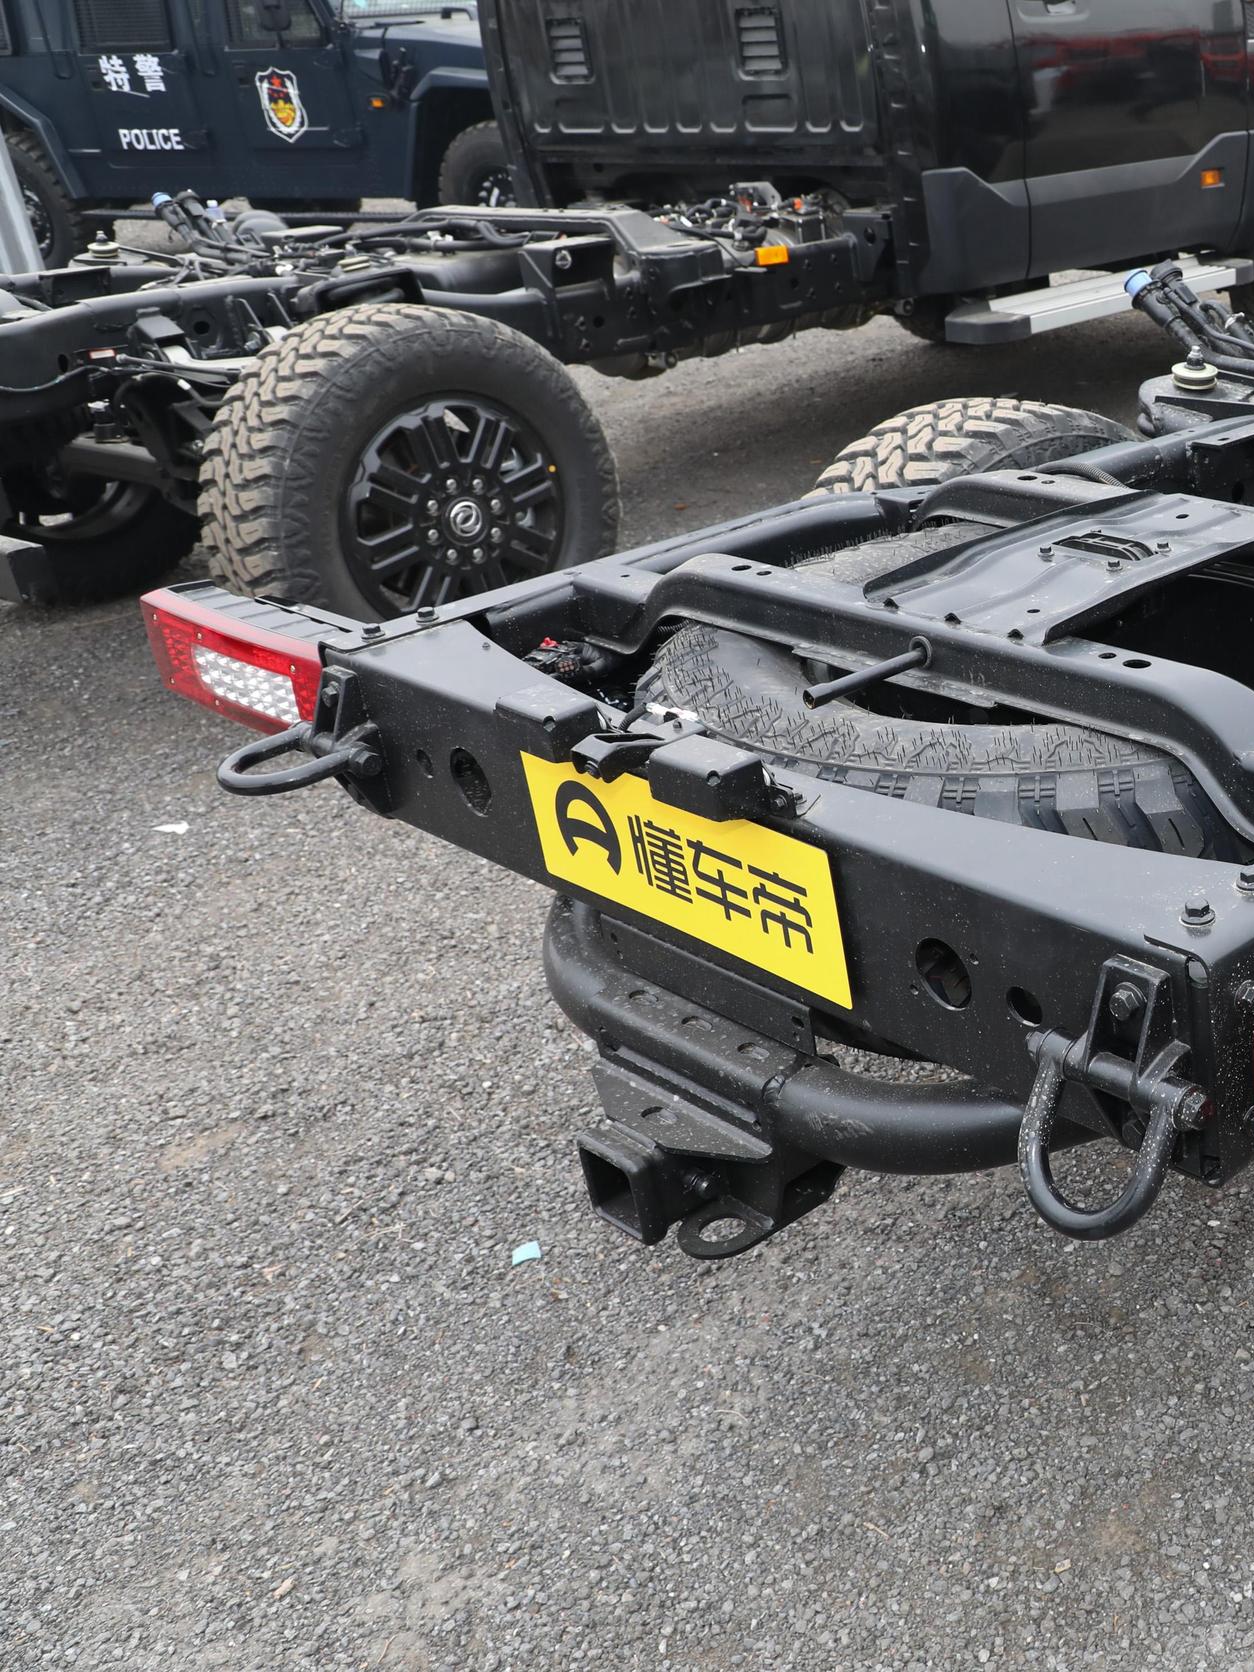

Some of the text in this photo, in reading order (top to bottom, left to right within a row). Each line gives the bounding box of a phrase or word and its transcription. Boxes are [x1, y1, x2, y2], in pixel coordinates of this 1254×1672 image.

[98, 53, 166, 92] 特警
[118, 128, 185, 150] POLICE
[626, 814, 814, 954] 懂车帝
